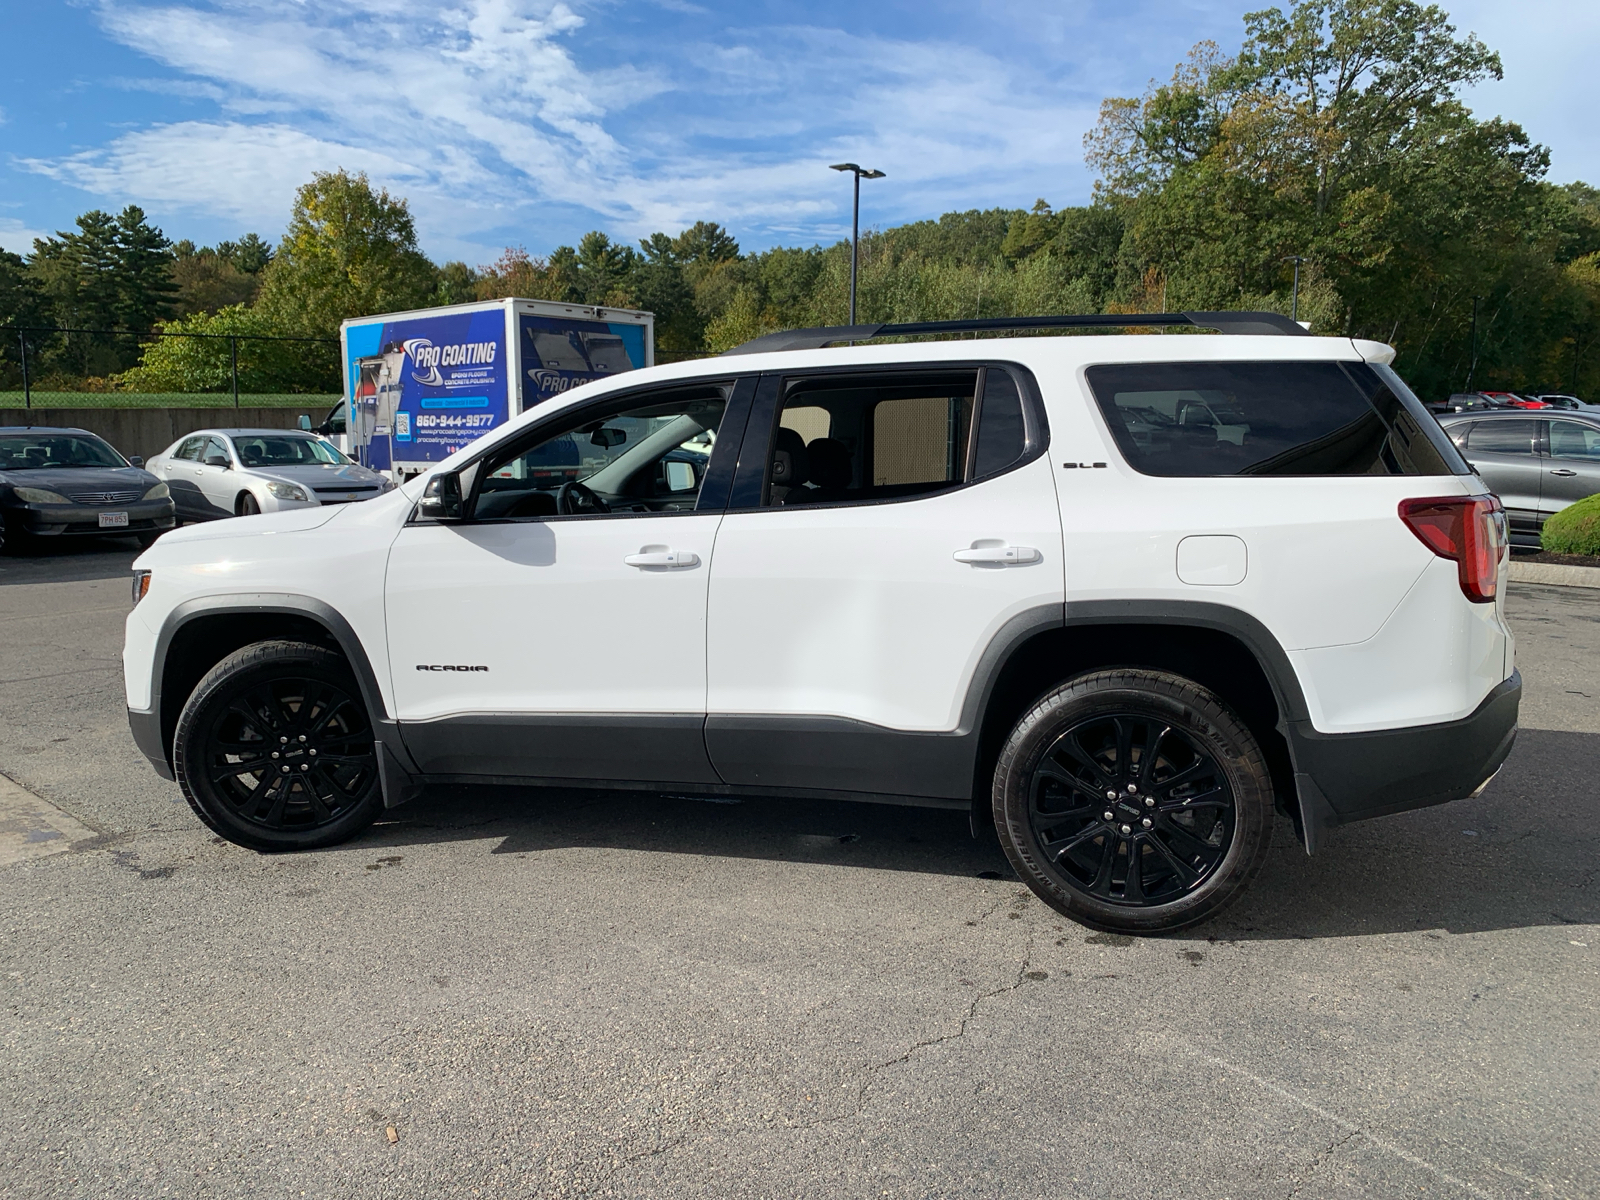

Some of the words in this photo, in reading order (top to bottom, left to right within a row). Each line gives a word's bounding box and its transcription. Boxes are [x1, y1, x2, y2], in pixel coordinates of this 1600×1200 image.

[415, 346, 441, 368] PRO
[441, 341, 497, 366] COATING
[541, 376, 568, 392] PRO
[416, 414, 495, 427] 860-944-9977
[114, 515, 127, 523] 853
[416, 664, 489, 672] ACADIA
[1011, 823, 1053, 887] MICHELIN
